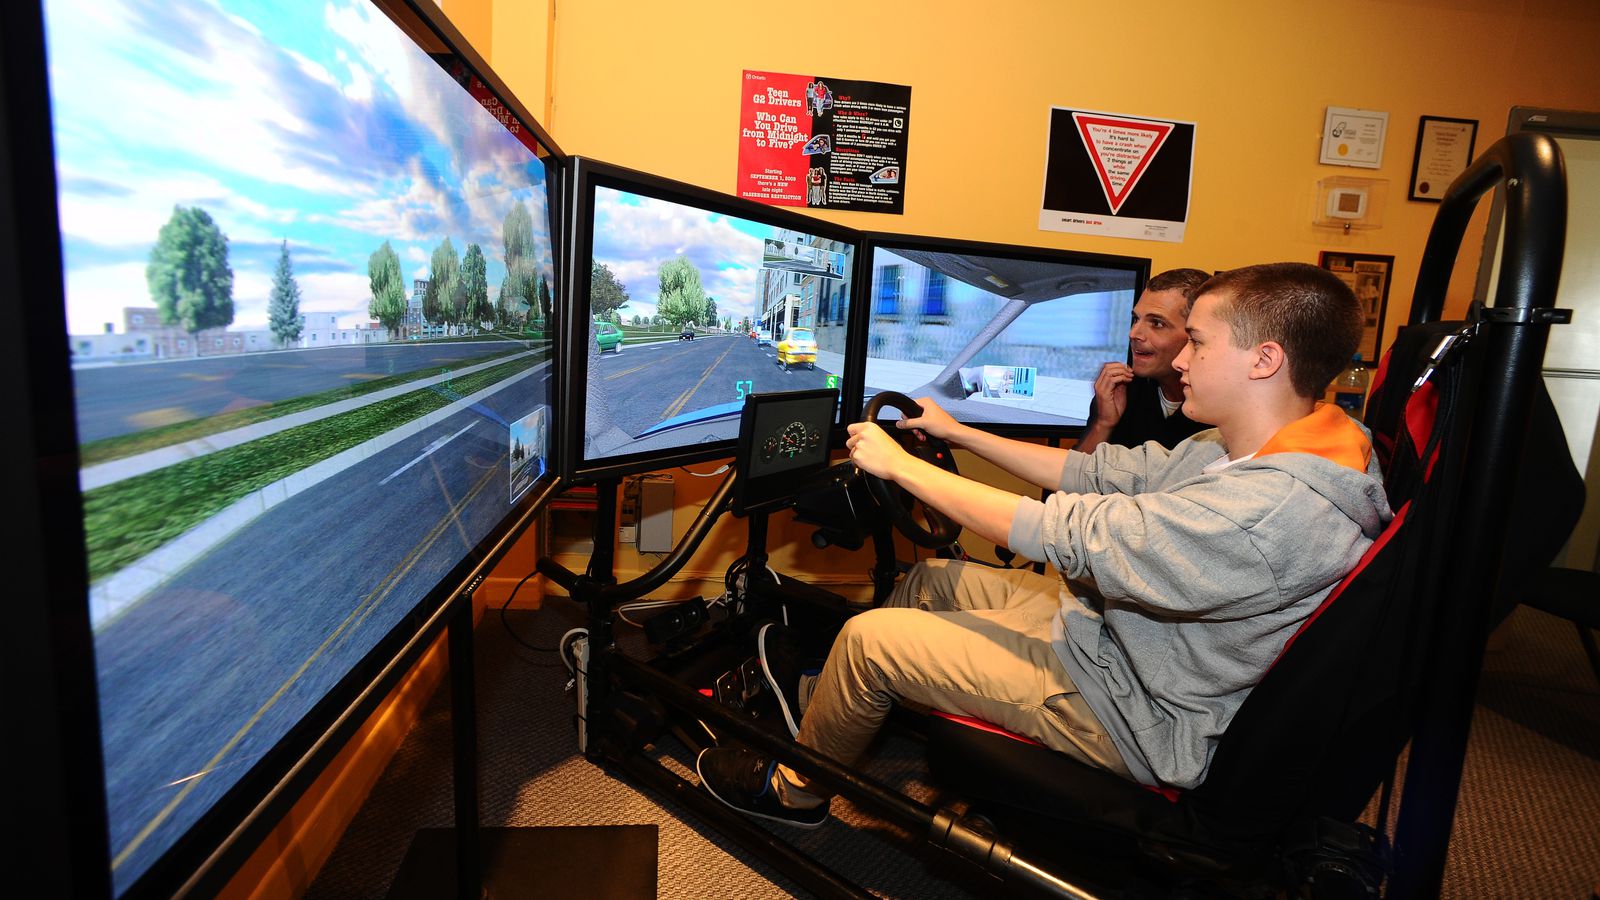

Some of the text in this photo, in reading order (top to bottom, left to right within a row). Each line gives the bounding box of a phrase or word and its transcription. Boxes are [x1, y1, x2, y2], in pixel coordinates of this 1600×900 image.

[767, 87, 788, 98] Teen
[753, 94, 802, 107] G2 Drivers
[756, 112, 796, 124] Who Can
[754, 121, 798, 132] You Drive
[743, 128, 808, 143] from Midnight
[756, 138, 794, 149] to Five?
[736, 377, 835, 400] 57 S
